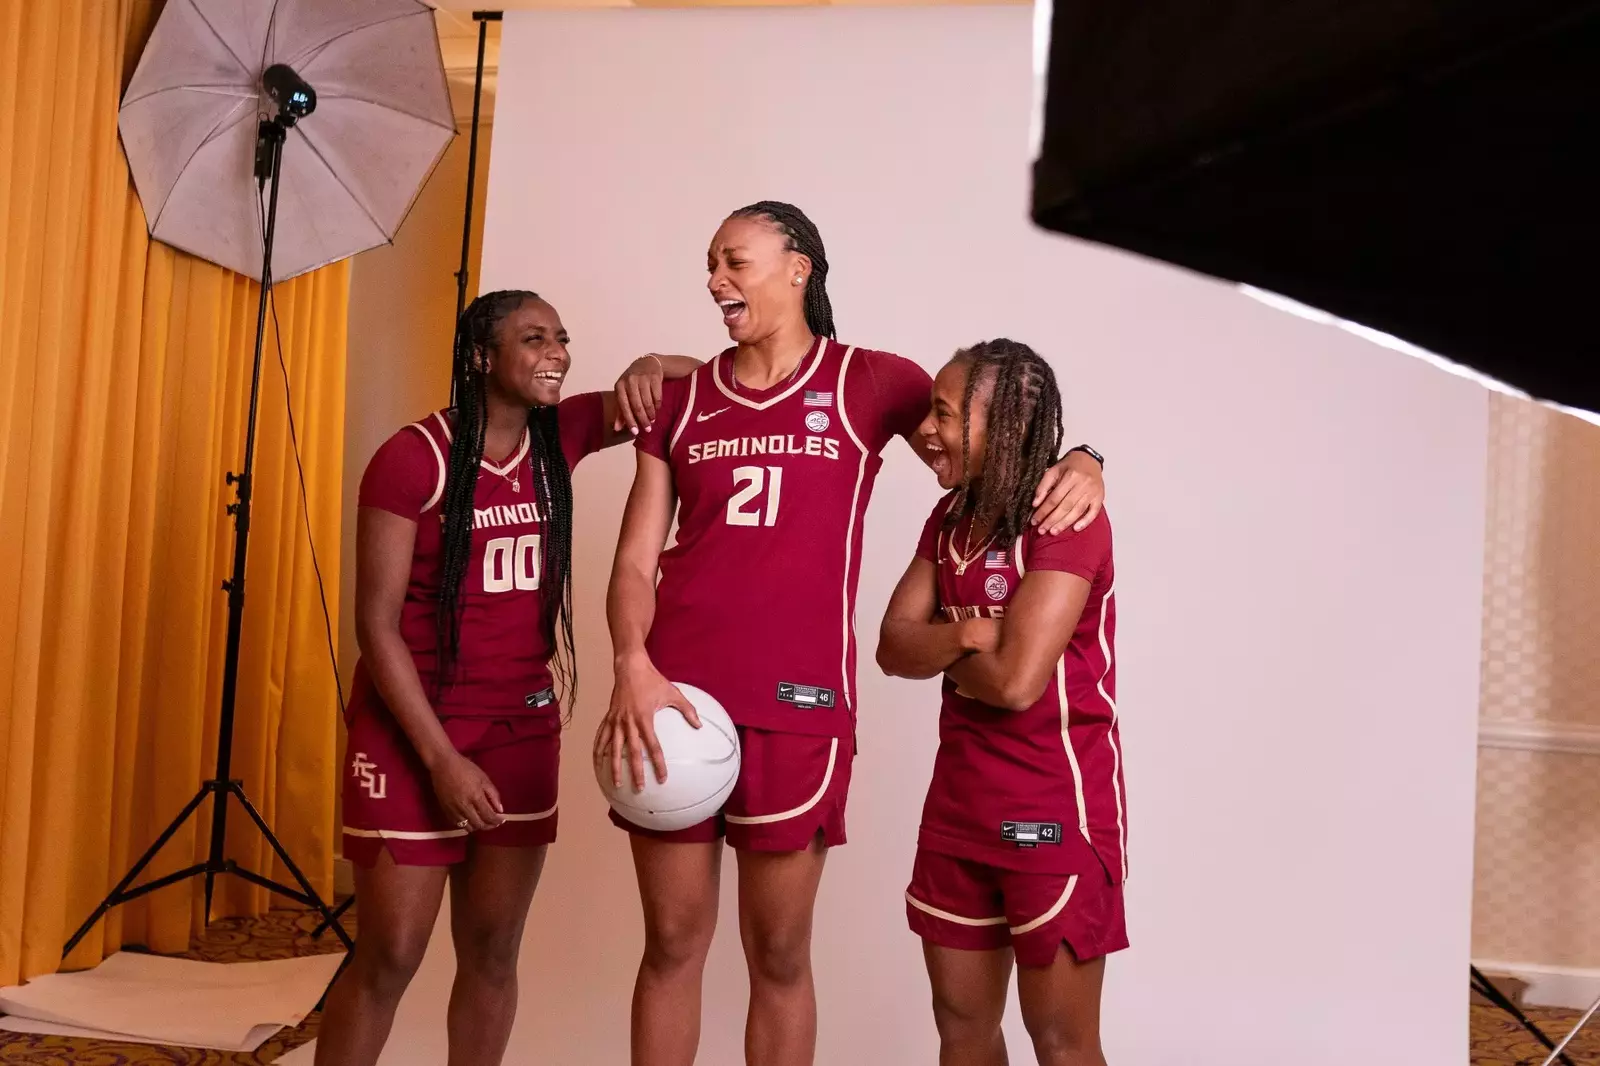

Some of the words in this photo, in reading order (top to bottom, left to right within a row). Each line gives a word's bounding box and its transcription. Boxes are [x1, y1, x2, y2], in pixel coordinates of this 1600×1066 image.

[688, 434, 840, 464] SEMINOLES
[726, 465, 783, 527] 21
[483, 534, 541, 593] 00
[819, 693, 829, 702] 46
[352, 752, 387, 799] FSU
[1041, 828, 1053, 838] 42
